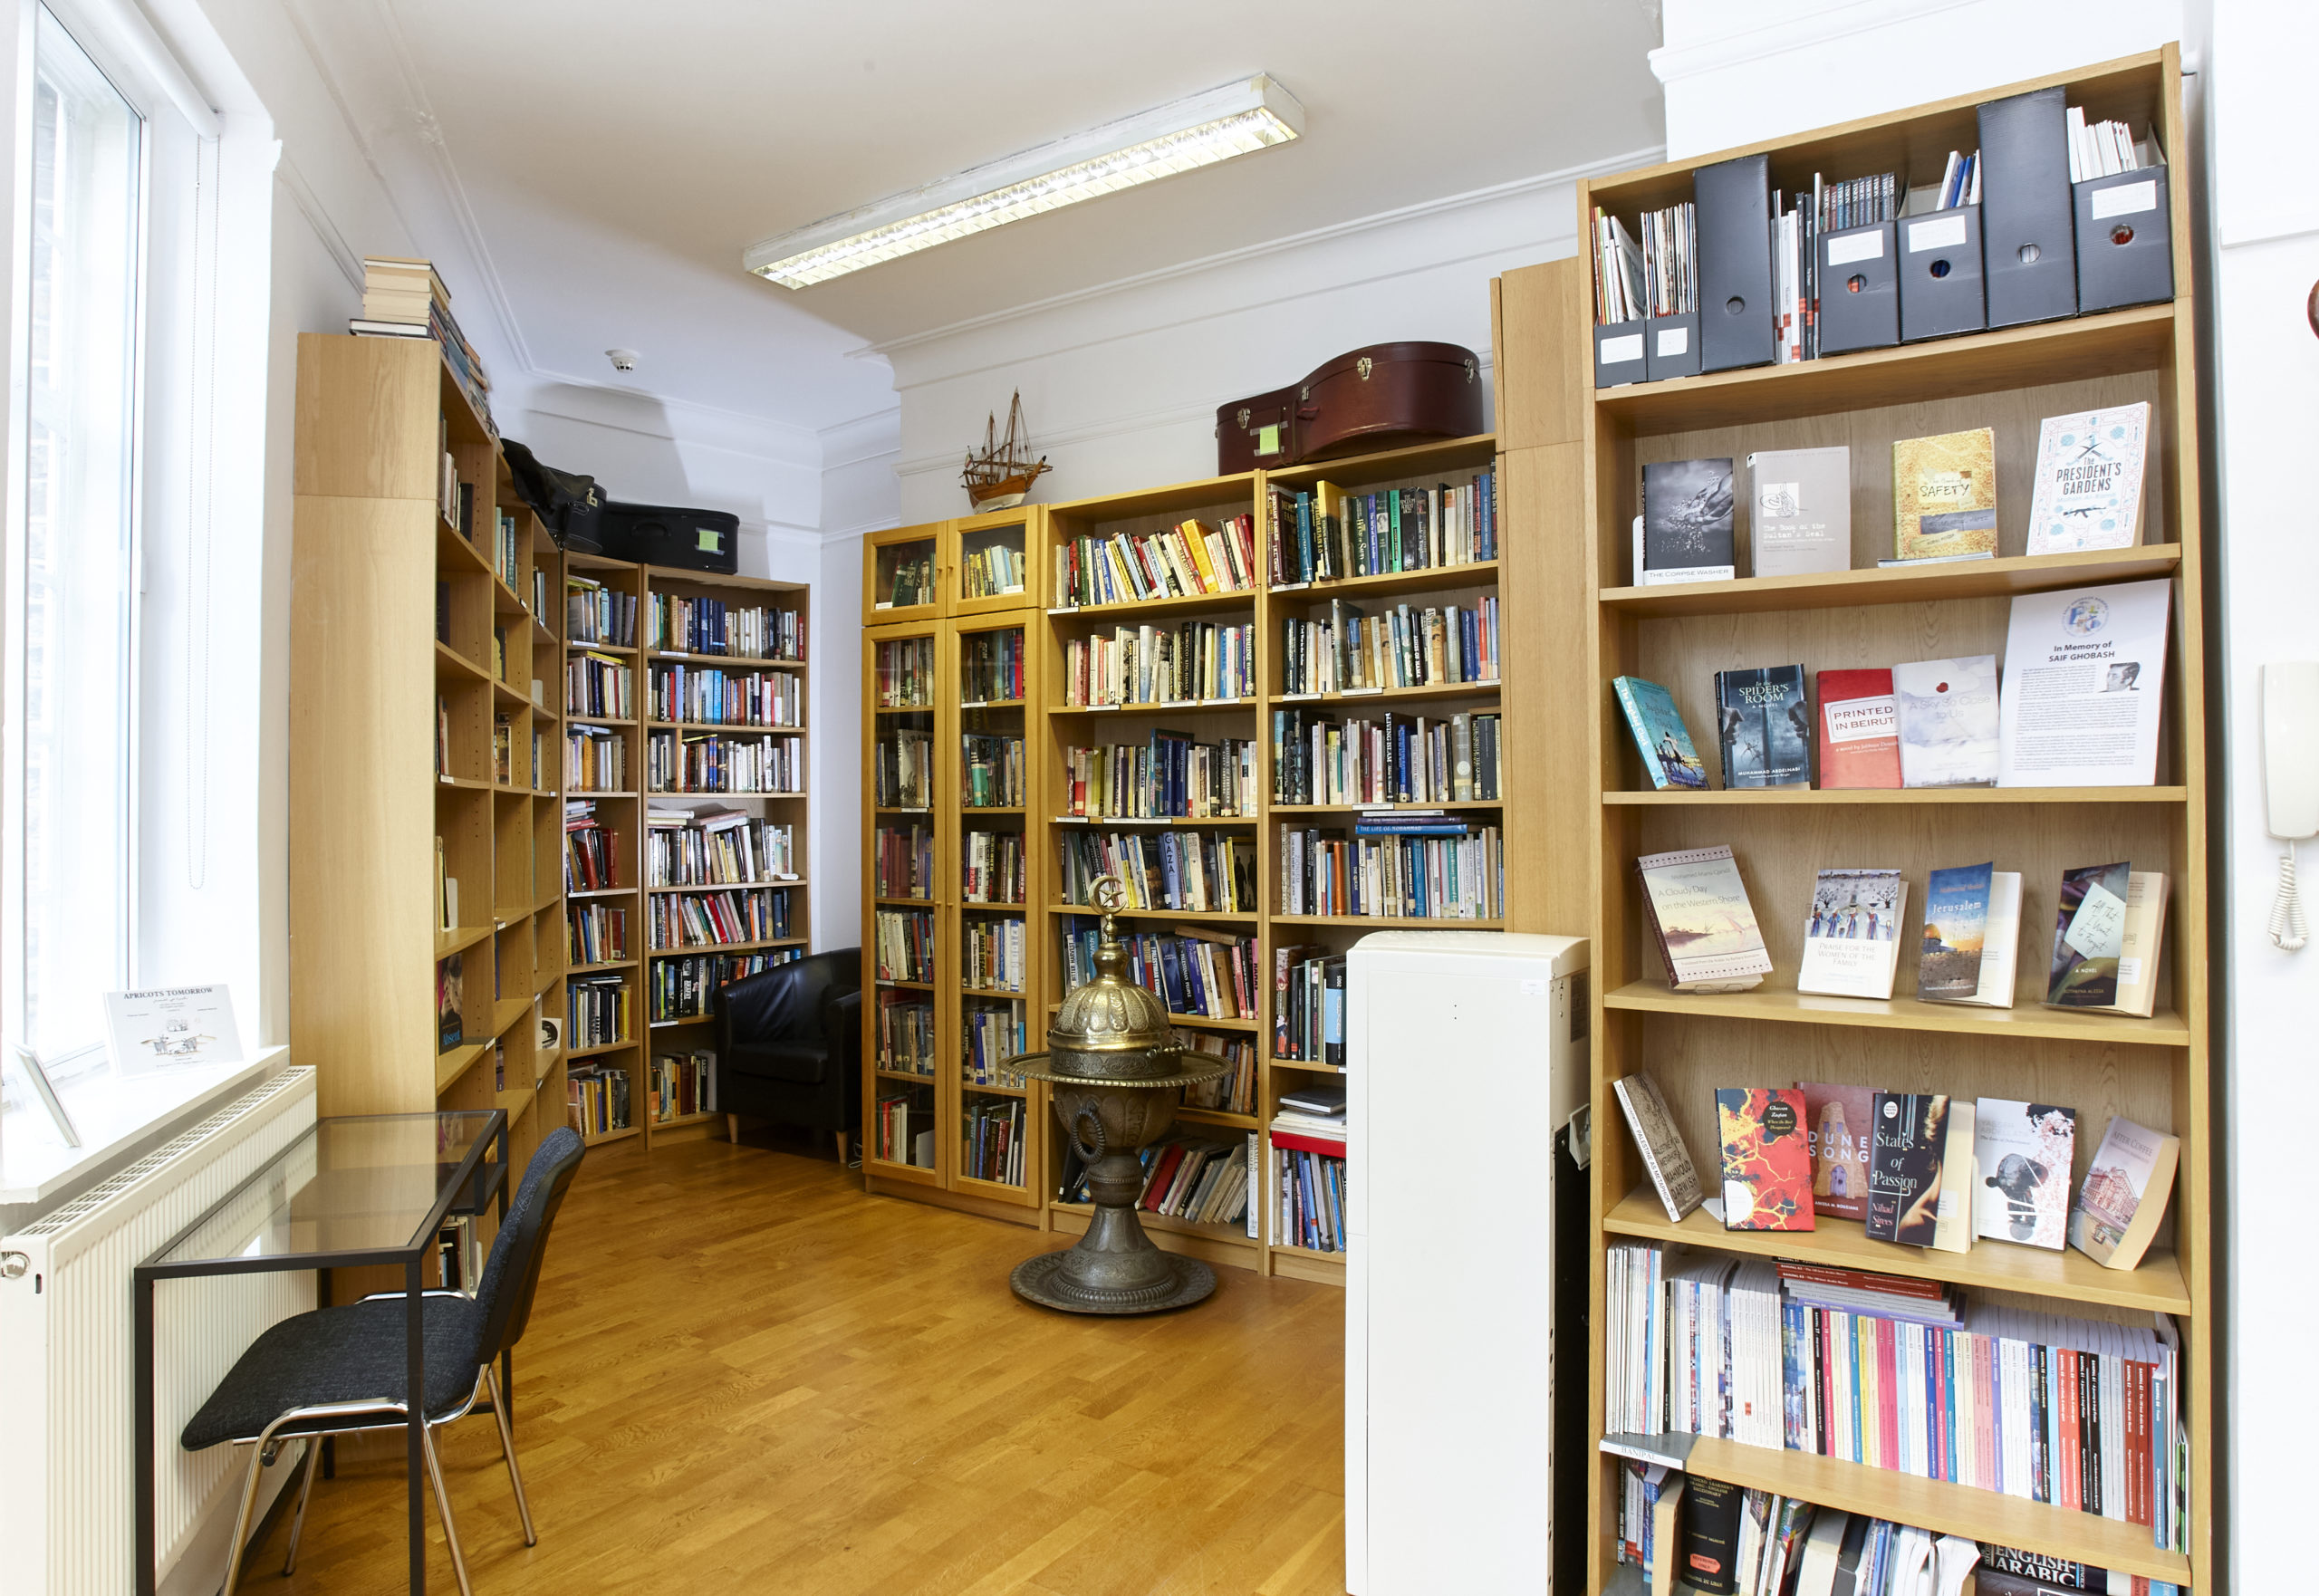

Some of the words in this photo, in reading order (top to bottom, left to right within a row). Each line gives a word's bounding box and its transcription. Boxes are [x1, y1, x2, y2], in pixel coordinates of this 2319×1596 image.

[2083, 457, 2094, 465] The
[2056, 462, 2122, 482] PRESIDENT'S
[1920, 484, 1969, 497] SAFETY
[2063, 478, 2111, 495] GARDENS
[2064, 643, 2100, 652] Memory
[2102, 640, 2112, 649] of
[2048, 654, 2068, 662] SAIF
[2070, 650, 2115, 660] GHOBASH
[1739, 683, 1789, 697] SPIDER'S
[1745, 692, 1784, 704] ROOM
[1920, 700, 1940, 710] Sky
[1959, 695, 1991, 706] Close
[1834, 706, 1893, 720] PRINTED
[1835, 722, 1848, 731] IN
[1851, 716, 1896, 729] BEIRUT
[1360, 824, 1370, 832] THE
[1371, 824, 1382, 832] LIFE
[1165, 834, 1176, 873] GAZA
[1665, 886, 1692, 897] Cloudy
[1692, 884, 1708, 895] Day
[1688, 898, 1718, 909] Western
[1932, 899, 1982, 915] Jerusalem
[124, 990, 165, 1000] APRICOTS
[168, 986, 214, 996] TOMORROW
[1808, 1130, 1869, 1149] DUNE
[1876, 1132, 1915, 1149] States
[2114, 1130, 2131, 1146] AFTER
[2131, 1139, 2153, 1157] COFFEE
[1808, 1144, 1870, 1163] SONG
[1636, 1130, 1654, 1163] PALESTINE
[1653, 1169, 1671, 1204] METAPHOR
[1663, 1159, 1692, 1184] MAHMOUD
[1891, 1158, 1905, 1171] of
[1873, 1170, 1918, 1189] Passion
[1670, 1176, 1698, 1199] DARWISH
[1872, 1202, 1894, 1215] Nihad
[1872, 1215, 1893, 1226] Sirees
[1621, 1446, 1656, 1461] BANIPAL
[1996, 1543, 2076, 1573] ENGLISH-
[1996, 1557, 2075, 1588] ARABIC
